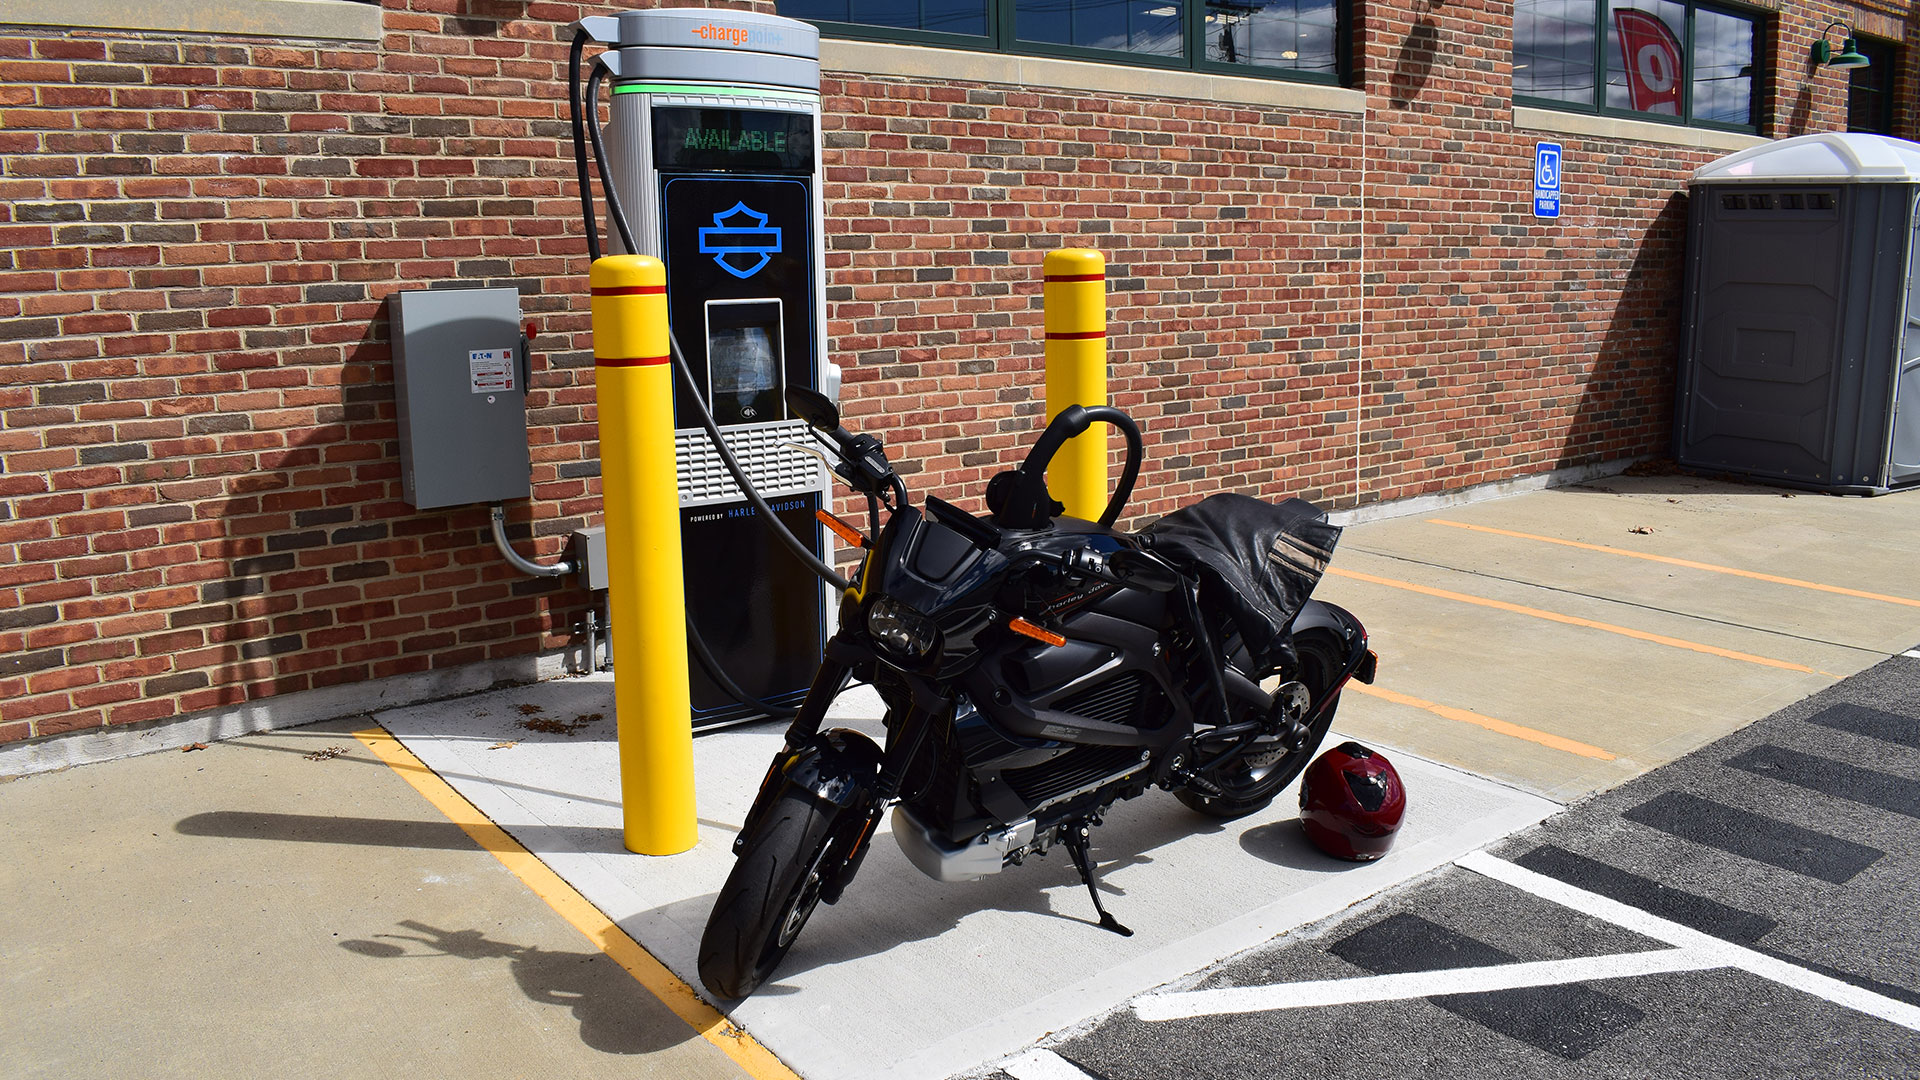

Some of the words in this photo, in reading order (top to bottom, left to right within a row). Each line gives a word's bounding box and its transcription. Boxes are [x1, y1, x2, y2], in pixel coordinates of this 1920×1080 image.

[684, 127, 786, 152] AVAILABLE
[1538, 200, 1556, 210] PARKING
[690, 514, 715, 522] POWERED
